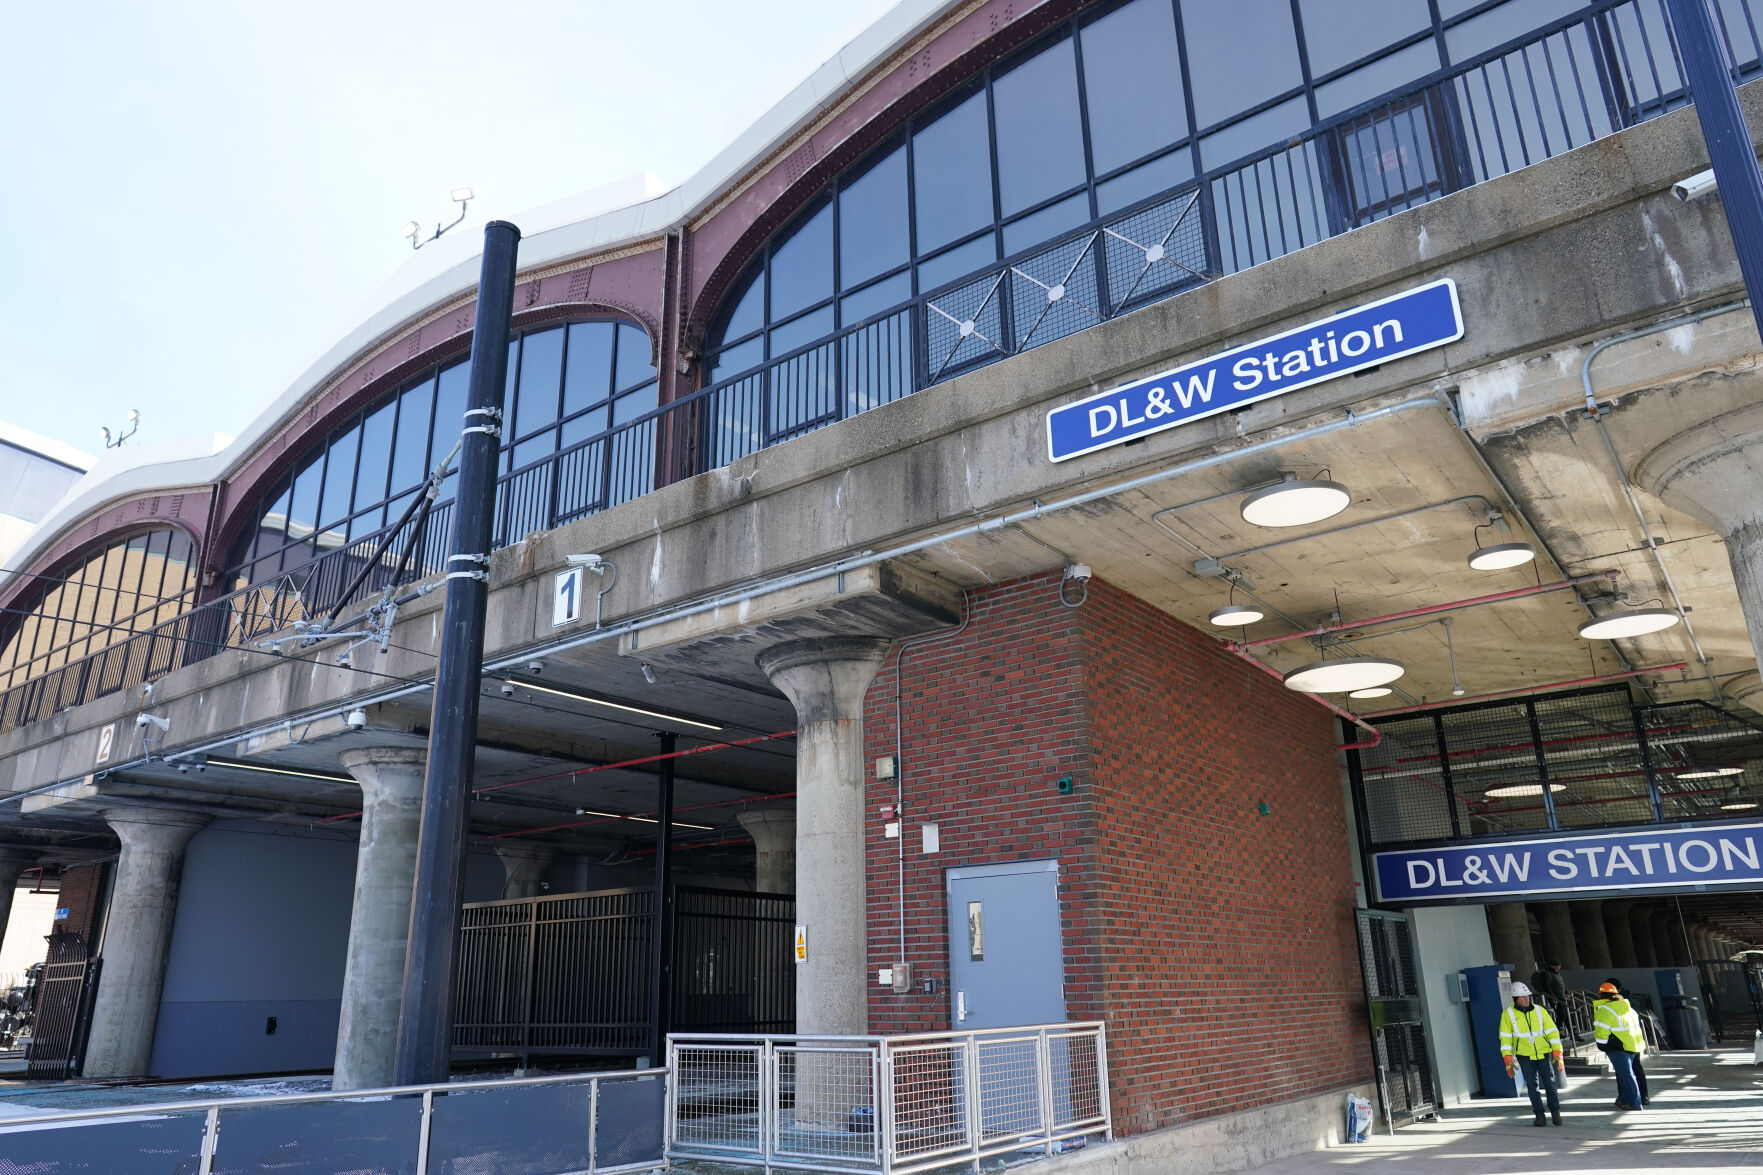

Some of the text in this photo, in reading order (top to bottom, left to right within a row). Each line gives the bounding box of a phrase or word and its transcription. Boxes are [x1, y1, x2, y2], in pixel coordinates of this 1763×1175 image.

[1088, 319, 1404, 438] DL&W Station
[561, 572, 576, 619] 1
[100, 728, 112, 760] 2
[1406, 836, 1761, 889] DL&W STATION
